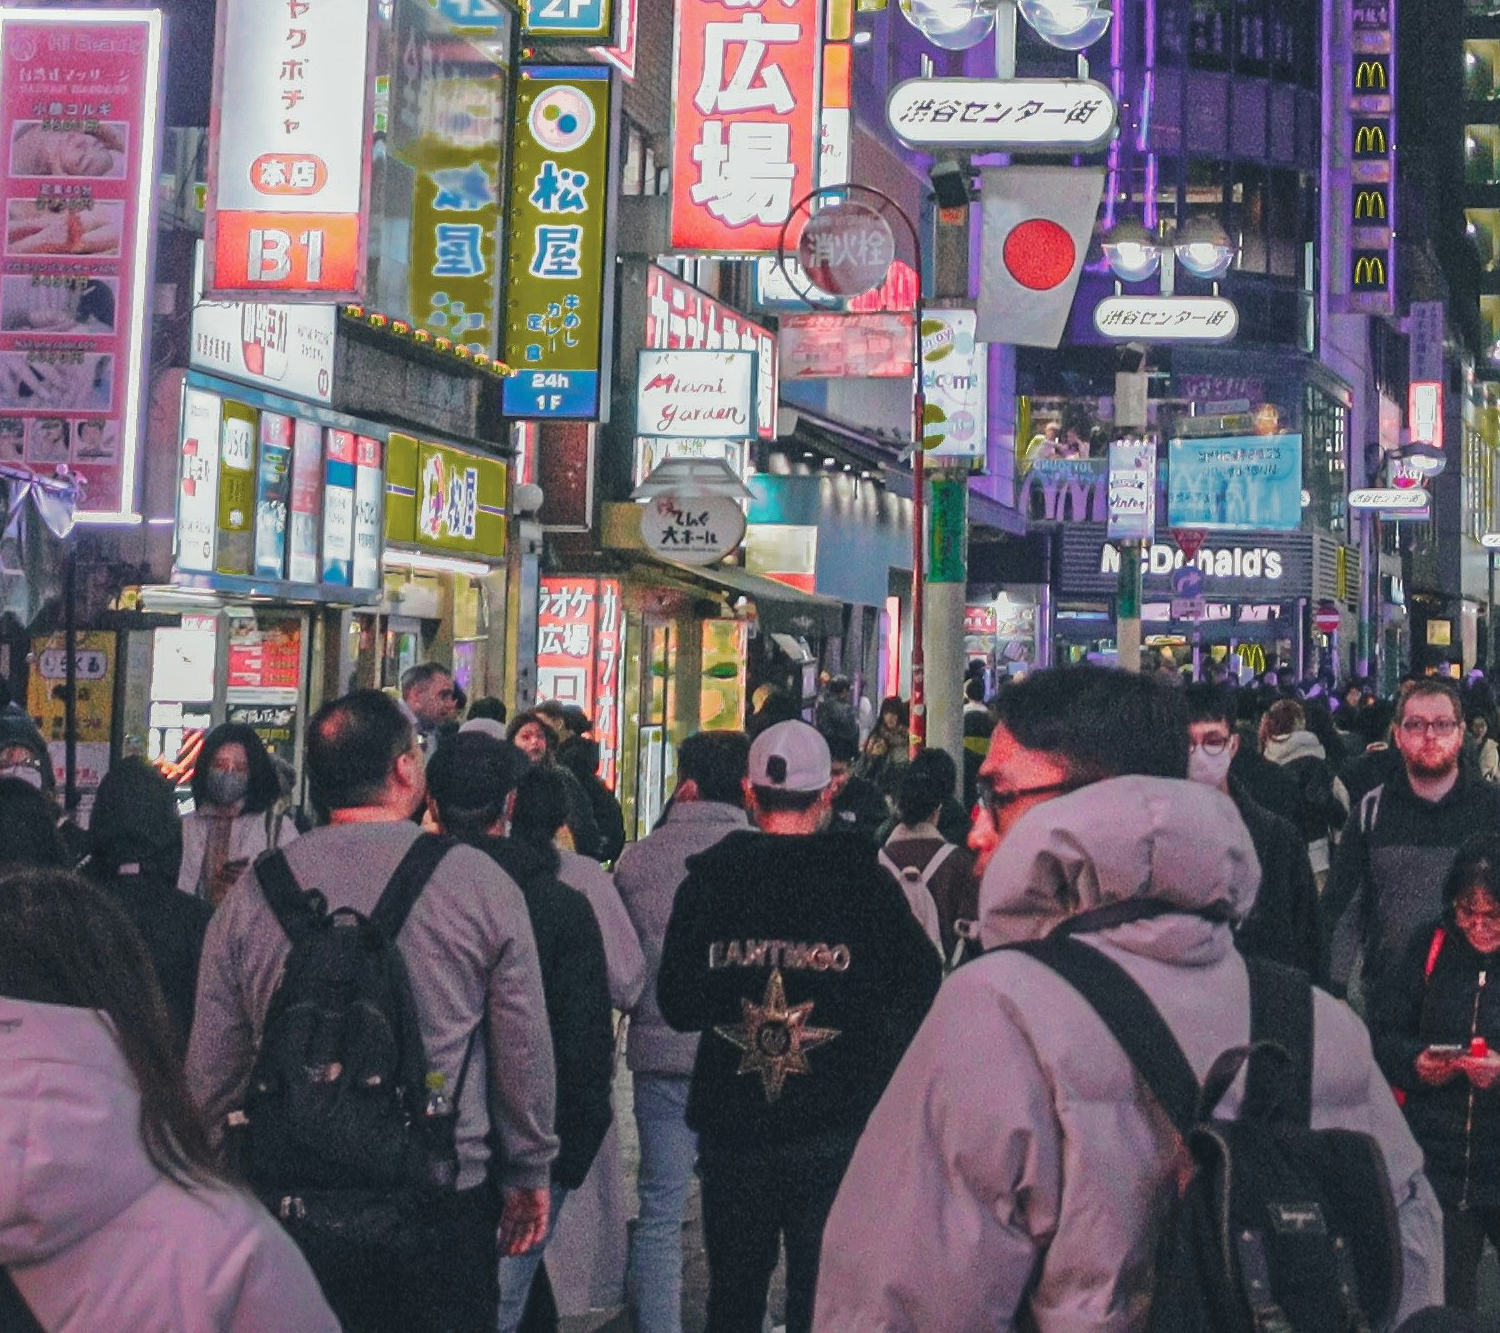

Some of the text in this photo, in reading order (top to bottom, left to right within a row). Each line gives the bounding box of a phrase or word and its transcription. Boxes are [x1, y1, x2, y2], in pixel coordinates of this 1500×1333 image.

[899, 99, 1103, 125] 渋谷センター街
[258, 159, 317, 189] 本店
[529, 160, 590, 280] 松屋
[247, 229, 326, 284] B1
[807, 232, 888, 268] 消火栓
[1100, 310, 1229, 327] 渋谷センター街
[531, 373, 570, 390] 24h
[643, 373, 727, 394] Miami
[922, 371, 978, 390] elcome
[536, 395, 562, 412] 1F
[537, 622, 592, 657] 広場
